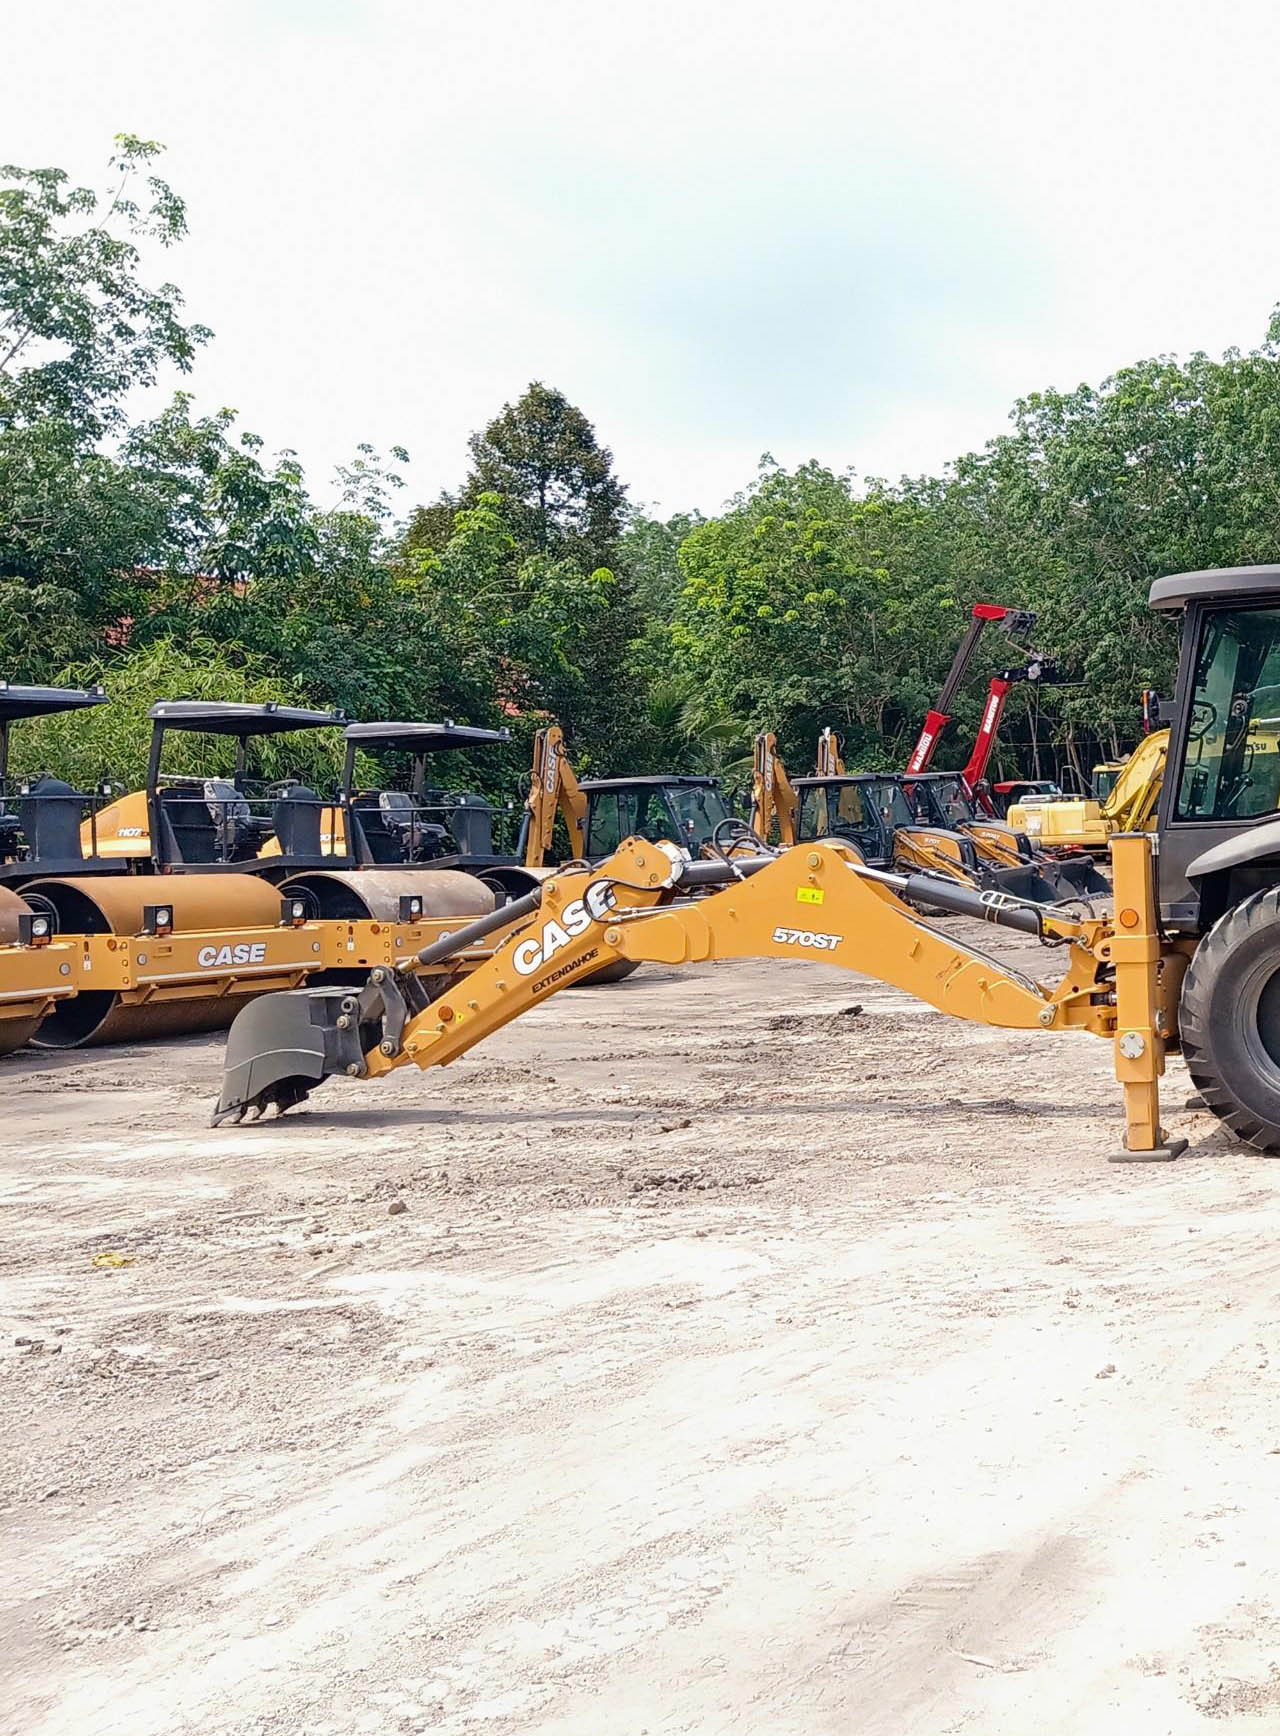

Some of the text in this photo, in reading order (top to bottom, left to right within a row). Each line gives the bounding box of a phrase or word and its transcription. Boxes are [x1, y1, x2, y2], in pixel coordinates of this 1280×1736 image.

[912, 731, 933, 772] MANITOU
[513, 879, 617, 976] CASE
[772, 927, 844, 951] 570ST
[197, 943, 267, 967] CASE
[531, 948, 600, 993] EXTENDAHOE
